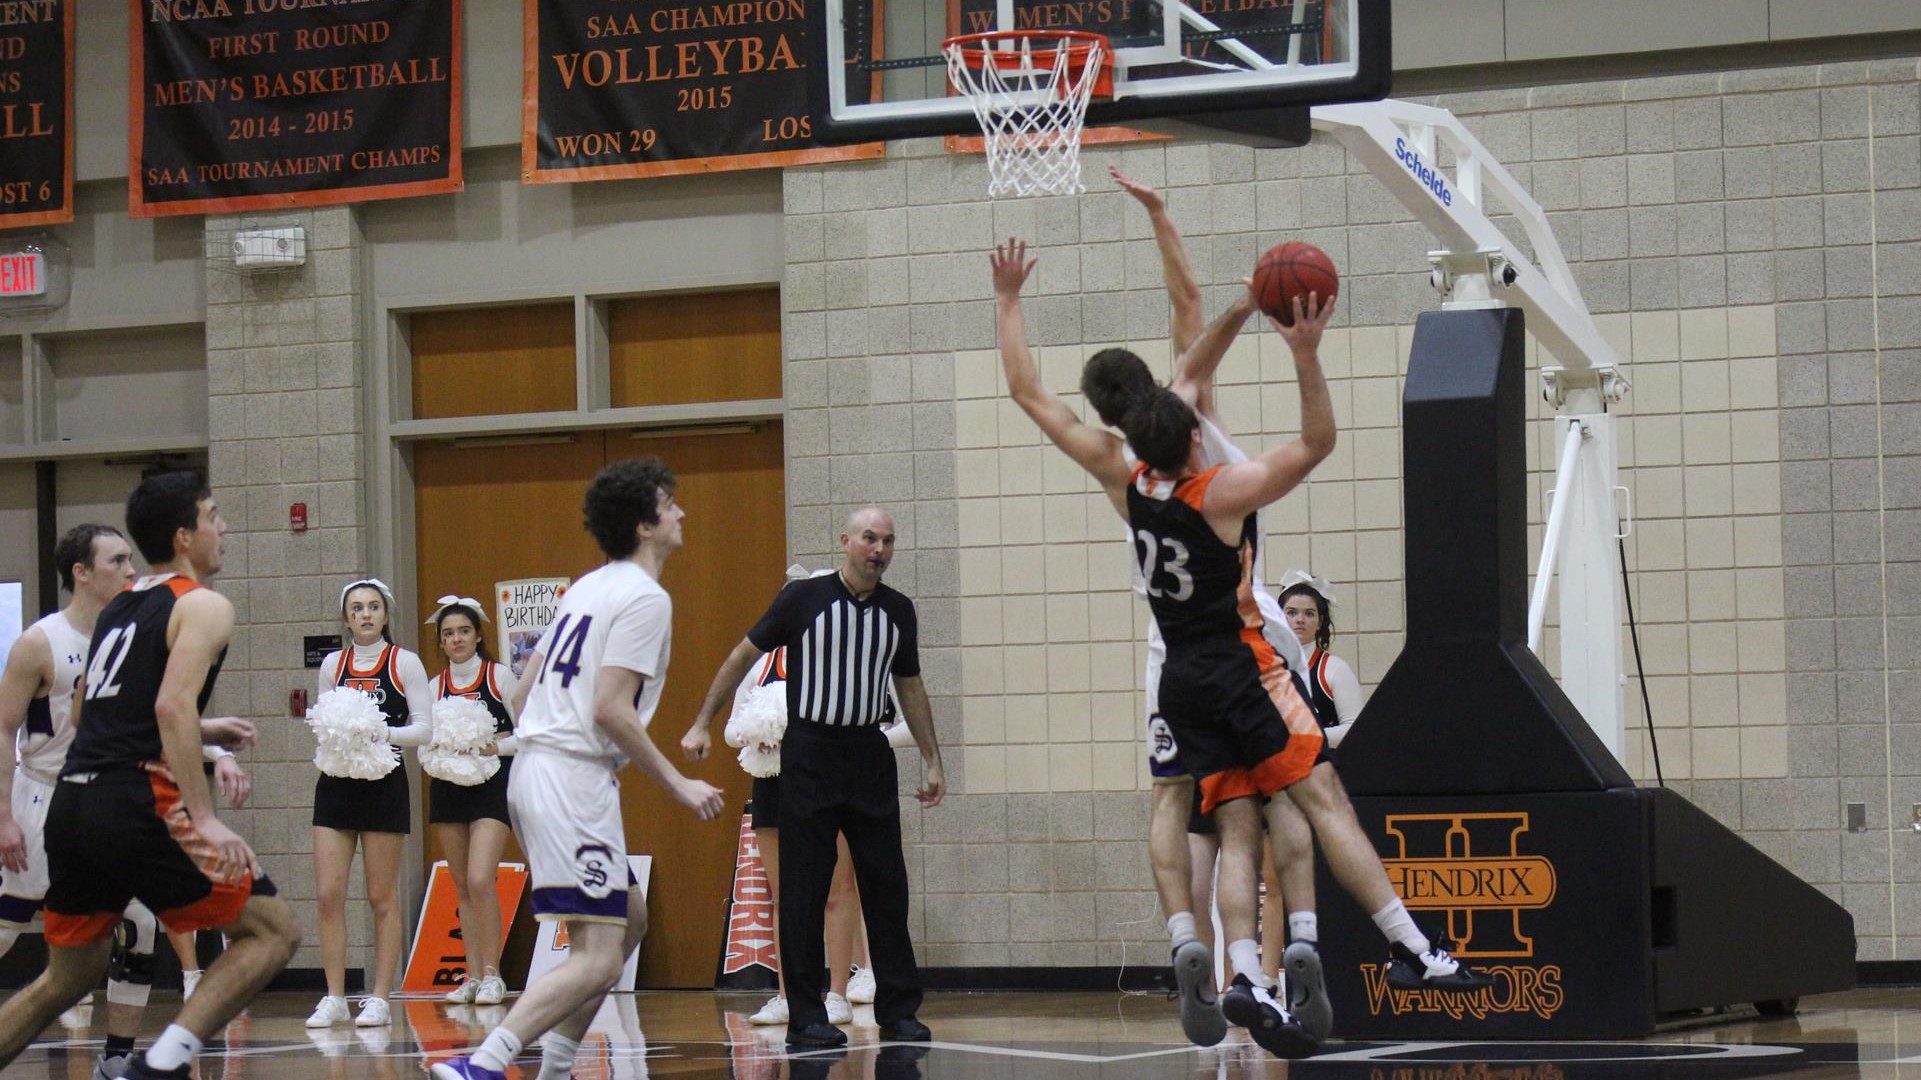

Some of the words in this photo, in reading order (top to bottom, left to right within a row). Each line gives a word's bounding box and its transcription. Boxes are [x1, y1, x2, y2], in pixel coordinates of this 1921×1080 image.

[0, 0, 56, 25] ENT
[151, 0, 232, 22] NCAA
[587, 13, 641, 39] SAA
[968, 0, 1111, 33] WMEN'S
[208, 31, 279, 58] FIRST
[296, 20, 390, 51] ROUND
[552, 33, 859, 90] VOLLEYBA
[154, 76, 245, 107] MEN'S
[253, 57, 446, 99] BASKETBALL
[677, 86, 733, 112] 2015
[0, 103, 54, 138] LL
[228, 115, 281, 140] 2014
[305, 108, 354, 134] 2015
[555, 130, 622, 159] WON
[630, 128, 657, 152] 29
[148, 167, 190, 186] SAA
[199, 153, 345, 183] TOURNAMENT
[351, 145, 440, 170] CHAMPS
[1395, 137, 1452, 207] Schelde
[0, 181, 32, 204] ST
[39, 180, 51, 201] 6
[0, 256, 36, 293] EXIT
[1136, 529, 1195, 602] 23
[514, 584, 559, 605] HAPPY
[84, 621, 137, 701] 42
[538, 612, 593, 689] 14
[1376, 866, 1535, 902] HENDRIX
